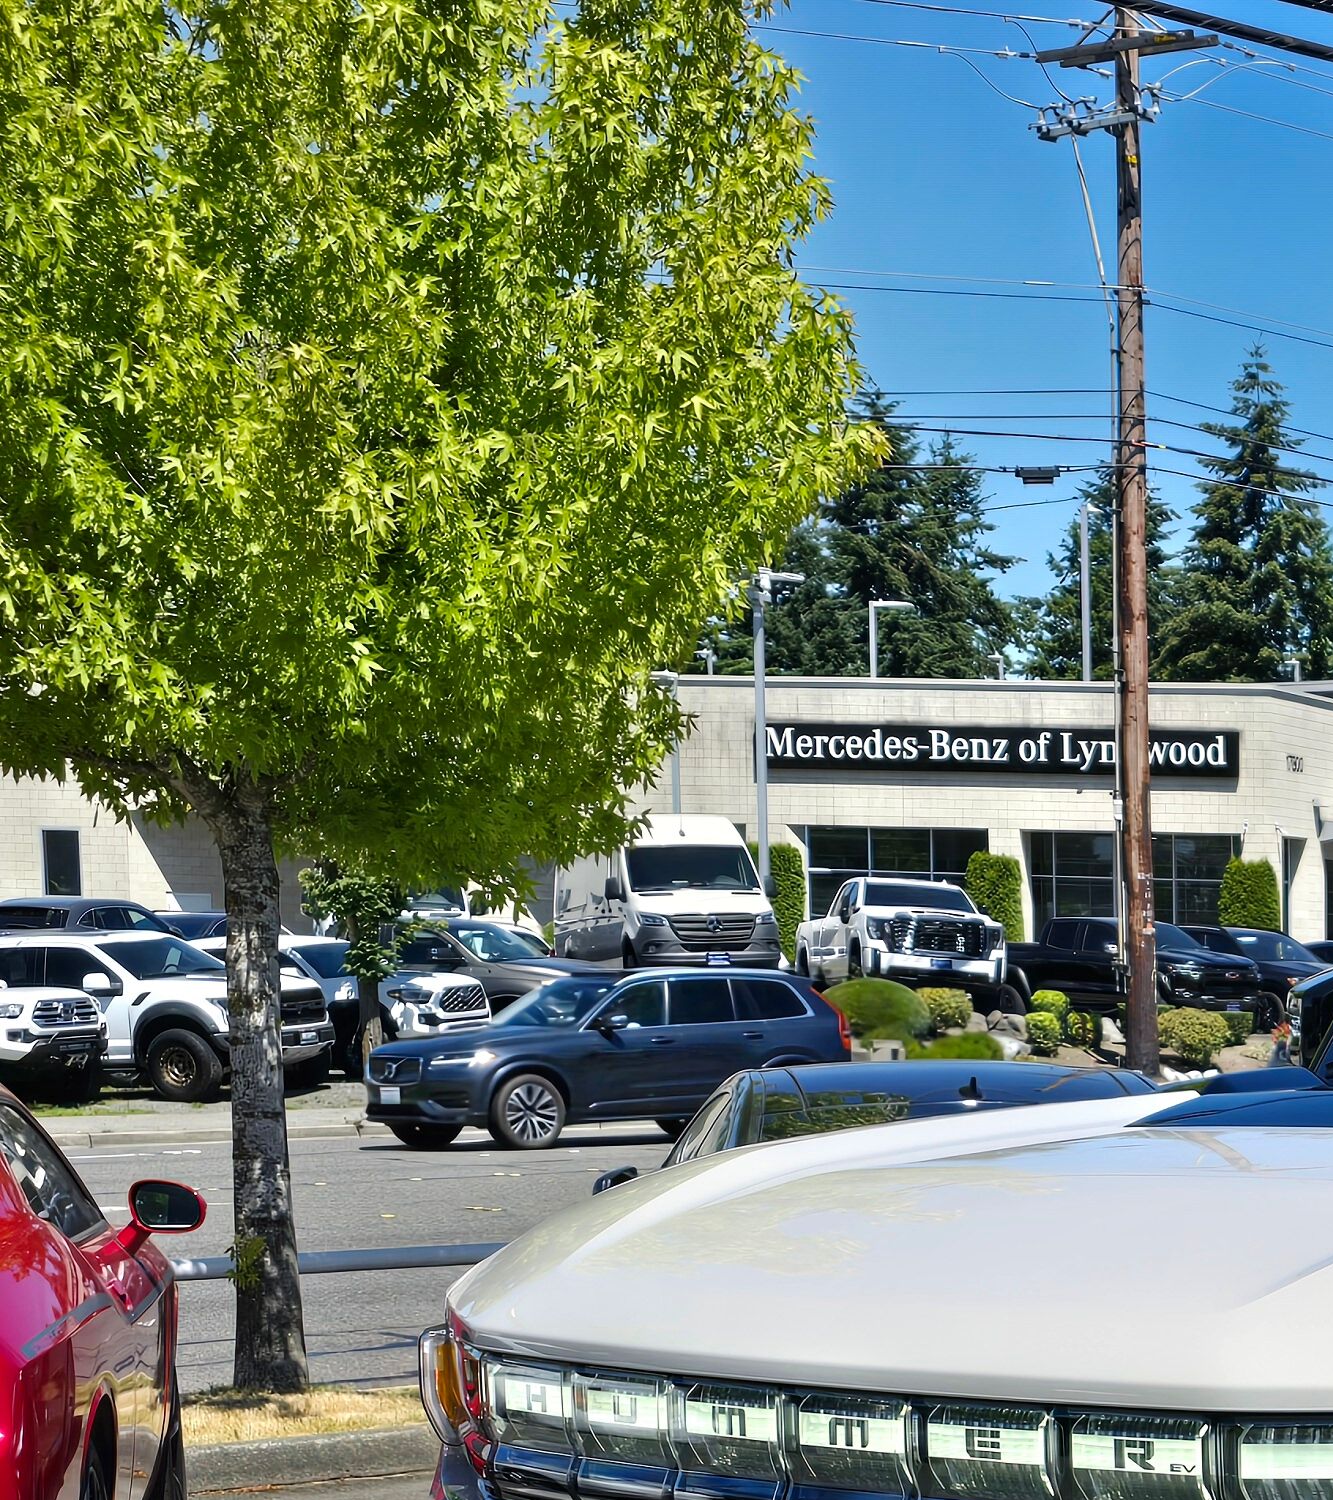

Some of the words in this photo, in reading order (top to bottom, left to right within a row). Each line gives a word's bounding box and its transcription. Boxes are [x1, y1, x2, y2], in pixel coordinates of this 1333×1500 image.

[765, 727, 1010, 762] Mercedes-Benz
[1018, 732, 1052, 762] of
[1060, 732, 1228, 771] Lynwood
[525, 1384, 1156, 1471] HUMMER
[1169, 1463, 1196, 1473] EV
